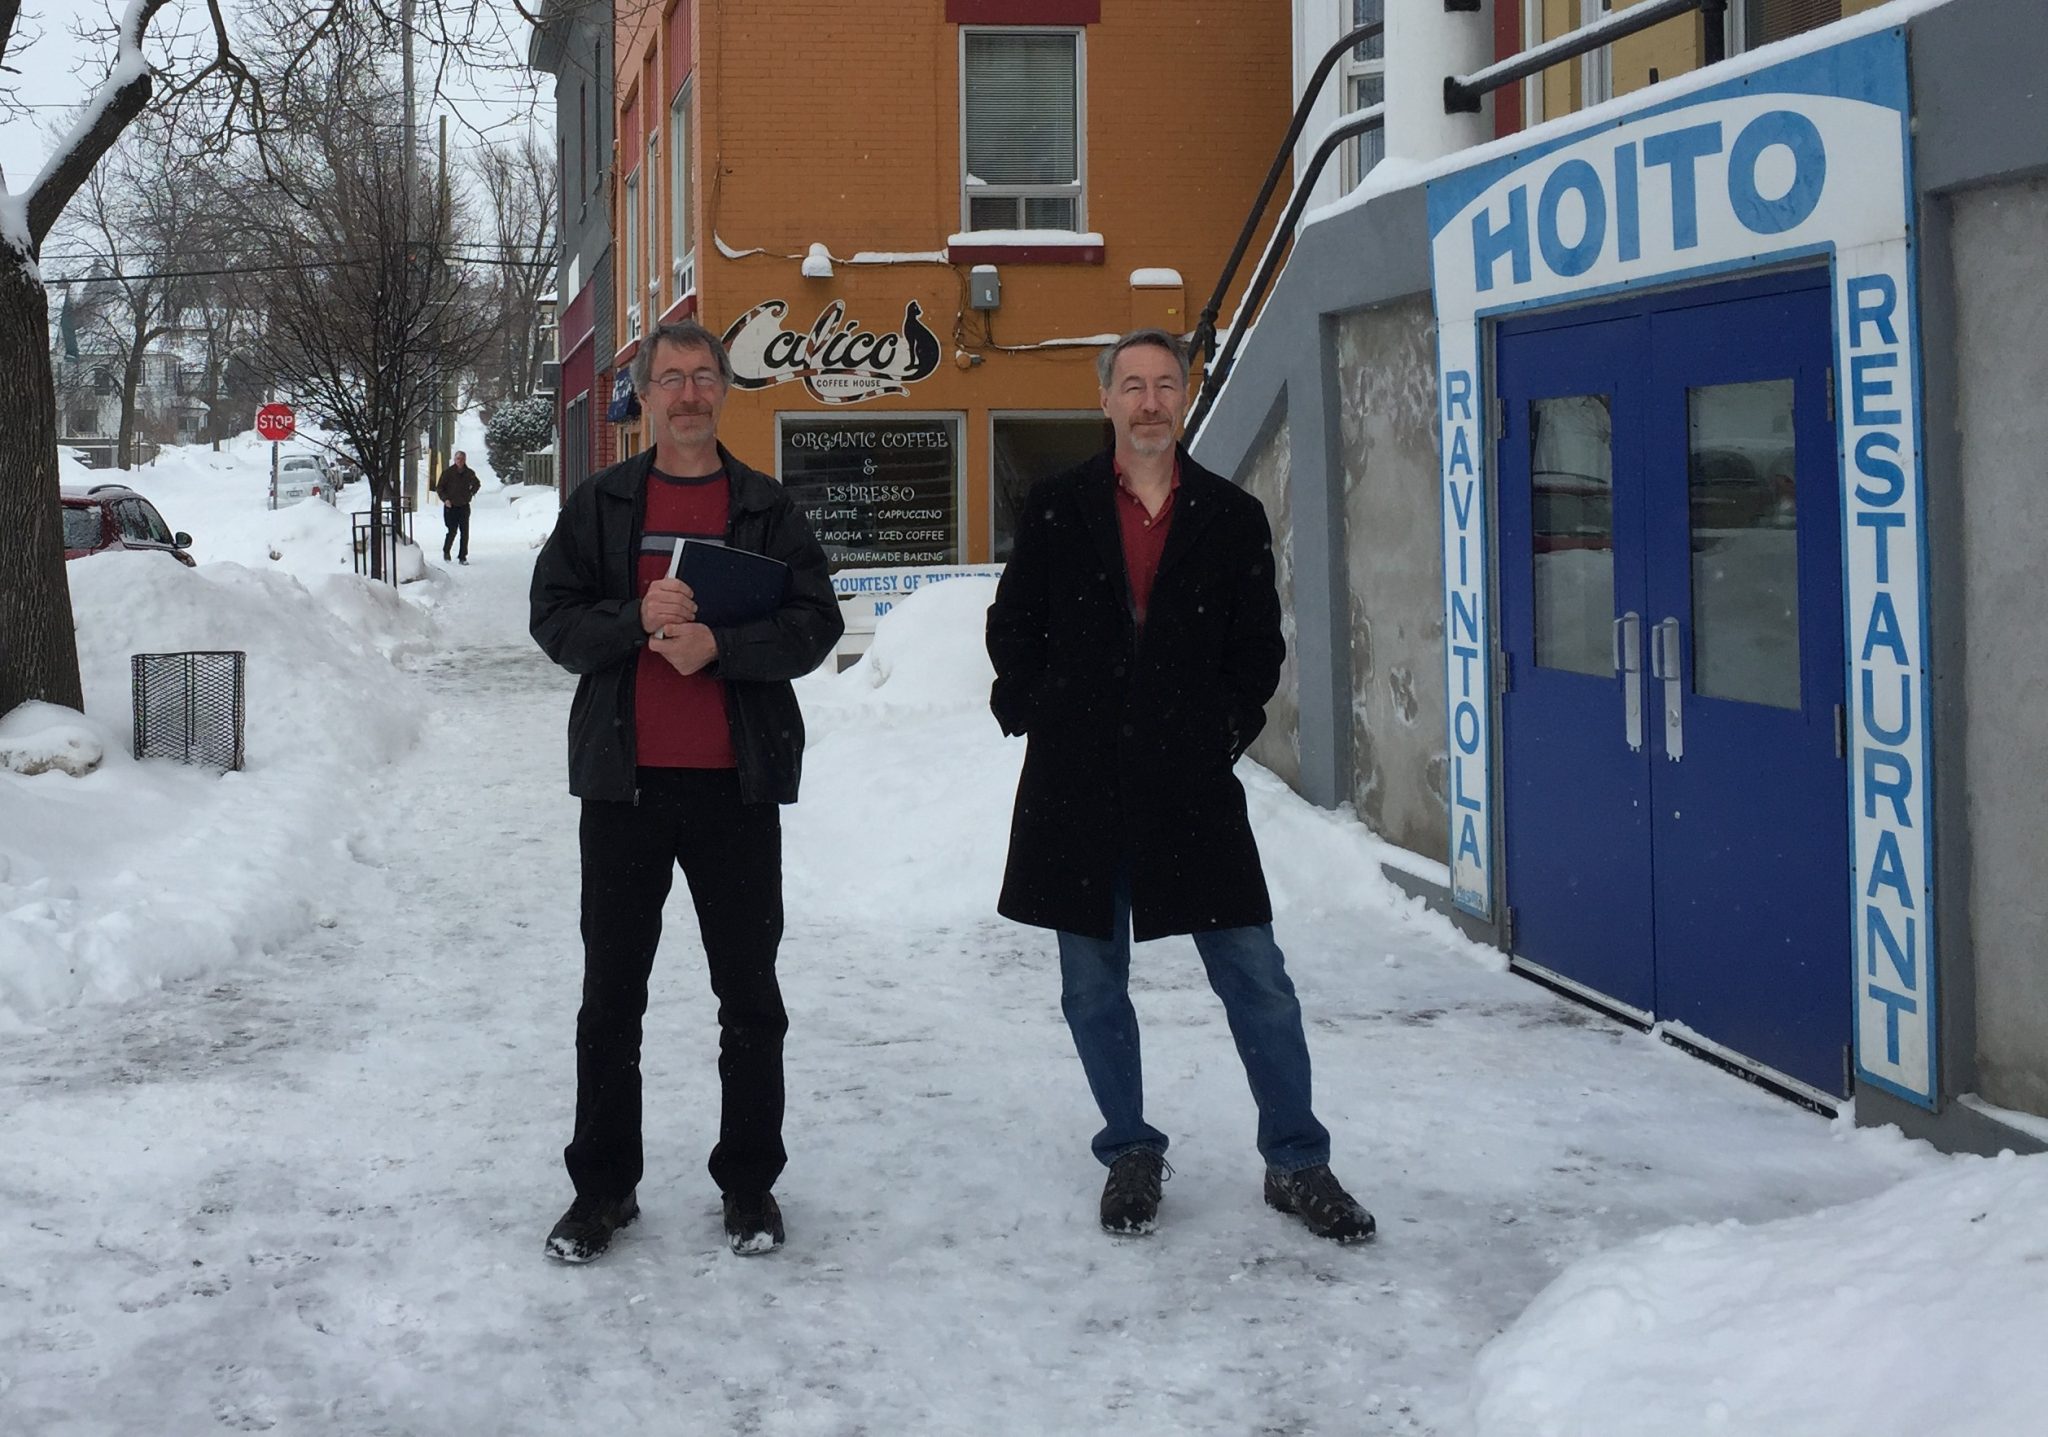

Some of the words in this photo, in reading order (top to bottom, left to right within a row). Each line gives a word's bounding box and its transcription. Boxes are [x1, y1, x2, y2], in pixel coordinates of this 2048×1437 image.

[1471, 109, 1826, 293] HOITO
[722, 299, 899, 387] Calico
[816, 379, 849, 388] COFFEE
[852, 379, 881, 388] HOUSE
[259, 414, 293, 429] STOP
[791, 431, 876, 450] ORGANIC
[881, 431, 949, 448] COFFEE
[863, 458, 878, 475] &
[826, 484, 915, 504] ESPRESSO
[877, 509, 942, 520] CAPPUCCINO
[824, 531, 862, 541] MOCHA
[878, 530, 903, 541] ICED
[905, 530, 945, 541] COFFEE
[831, 552, 838, 562] &
[840, 552, 900, 562] HOMEMADE
[903, 552, 944, 562] BAKING
[831, 575, 898, 592] COURTESY
[903, 574, 921, 590] OF
[1445, 370, 1482, 869] RAVINTOLA
[1846, 273, 1918, 1066] RESTAURANT
